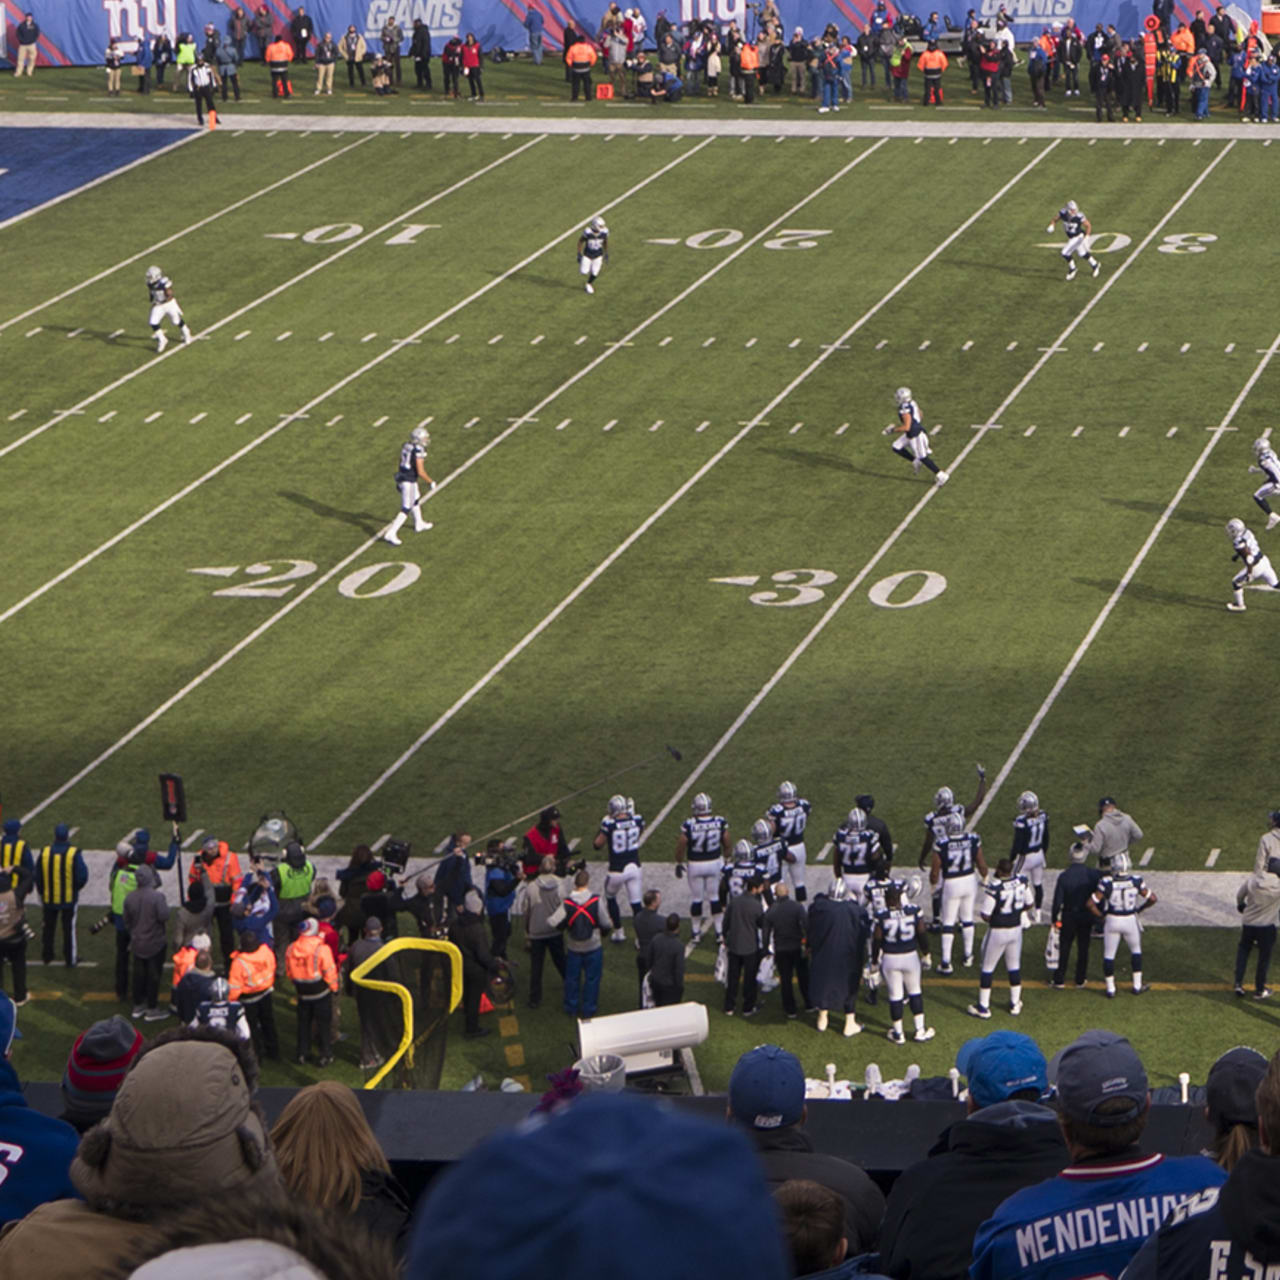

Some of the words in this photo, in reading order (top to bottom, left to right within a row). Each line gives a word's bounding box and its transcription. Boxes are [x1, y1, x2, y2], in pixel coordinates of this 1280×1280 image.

[212, 559, 422, 599] 20
[749, 568, 948, 608] 30
[612, 827, 640, 853] 82
[692, 830, 721, 852] 72
[840, 843, 868, 866] 77
[948, 849, 972, 872] 71
[1109, 888, 1139, 911] 46
[885, 917, 916, 942] 75
[1015, 1194, 1188, 1267] MENDENHA
